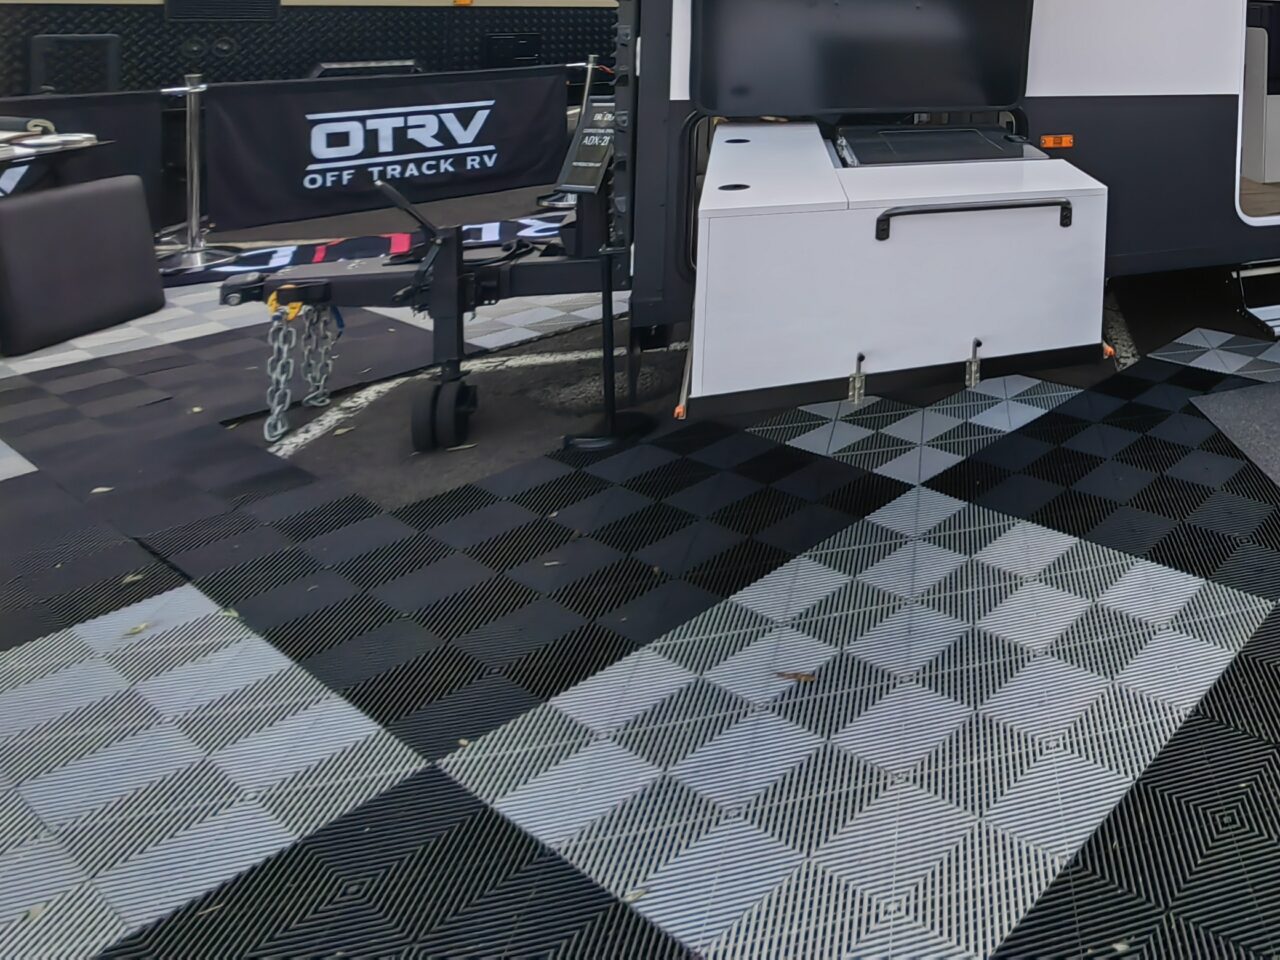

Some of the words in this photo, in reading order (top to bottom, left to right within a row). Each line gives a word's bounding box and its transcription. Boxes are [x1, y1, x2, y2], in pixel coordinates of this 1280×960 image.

[310, 109, 491, 160] OTRV
[303, 169, 355, 189] OFF
[367, 157, 455, 181] TRACK
[466, 153, 498, 170] RV
